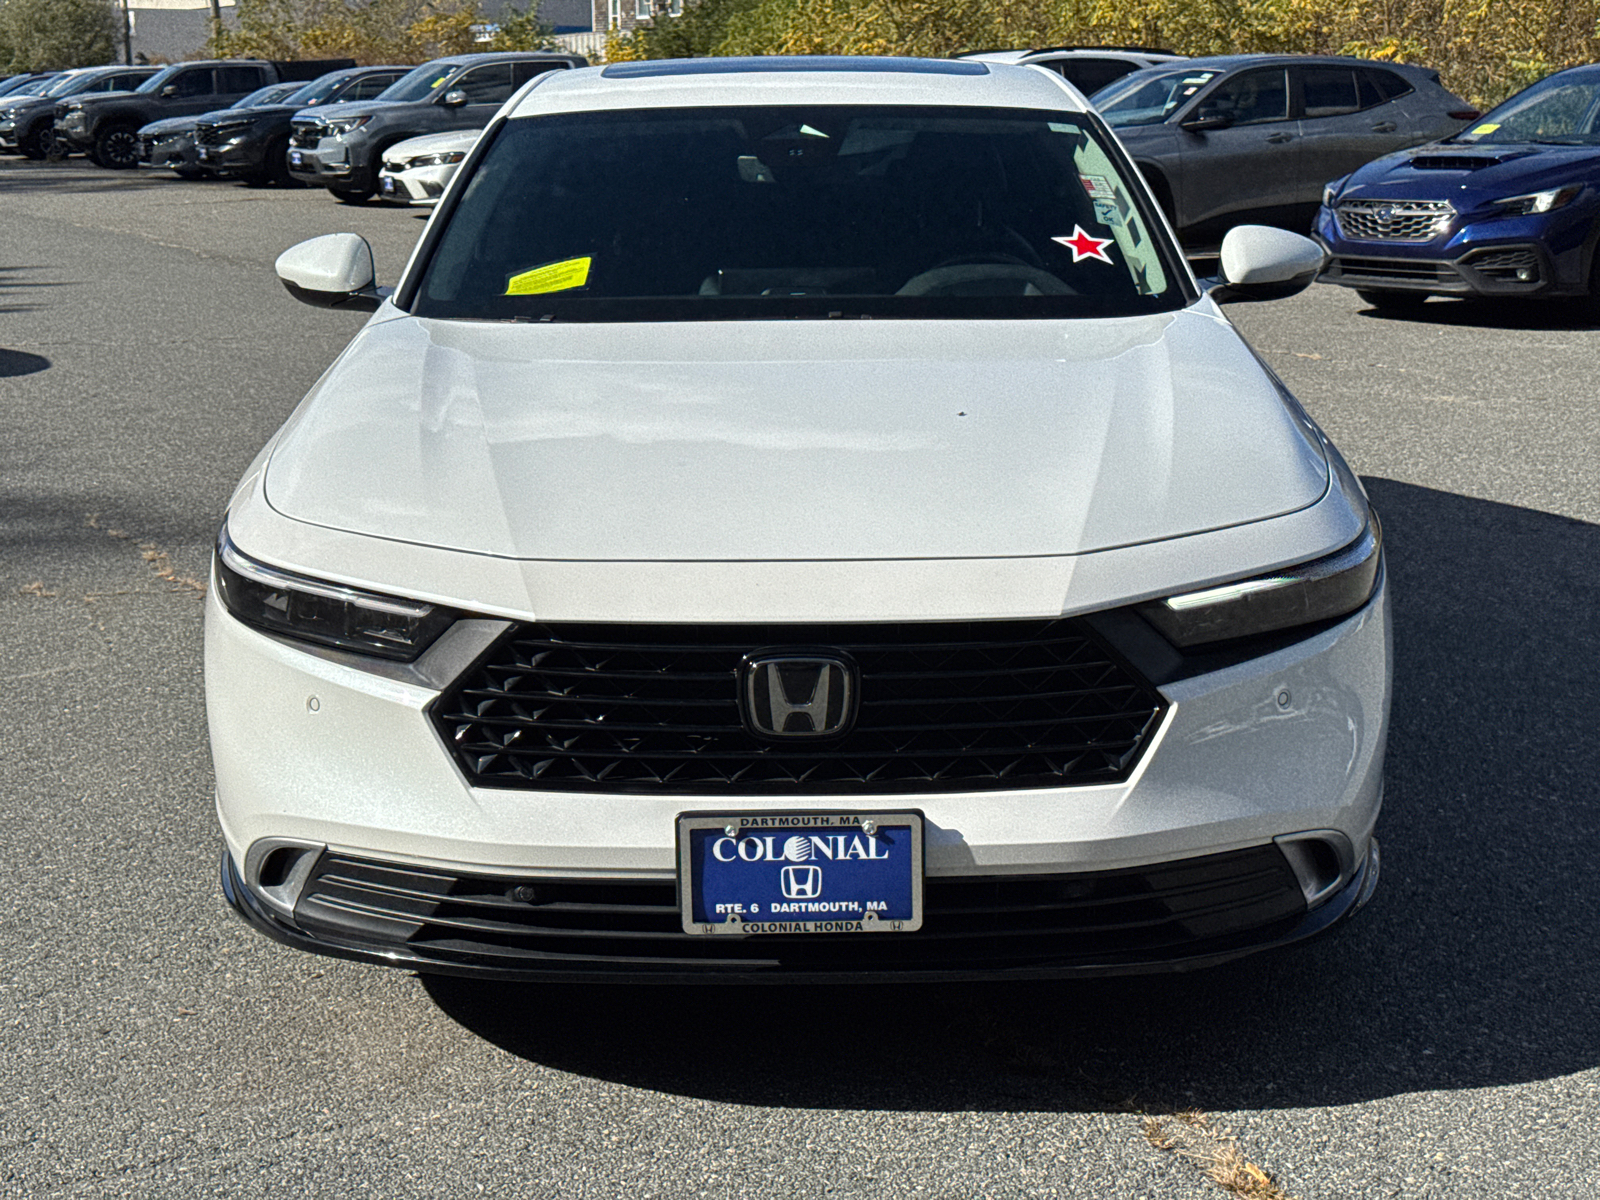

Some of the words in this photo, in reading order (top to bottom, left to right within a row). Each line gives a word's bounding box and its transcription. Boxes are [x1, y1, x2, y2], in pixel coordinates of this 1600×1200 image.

[839, 816, 861, 825] MA
[712, 835, 889, 862] COLONIAL
[715, 903, 747, 914] RTE.
[750, 903, 760, 913] 6
[770, 901, 863, 913] DARTMOUTH,
[866, 901, 888, 911] MA
[742, 922, 811, 933] COLONIAL
[814, 921, 864, 932] HONDA
